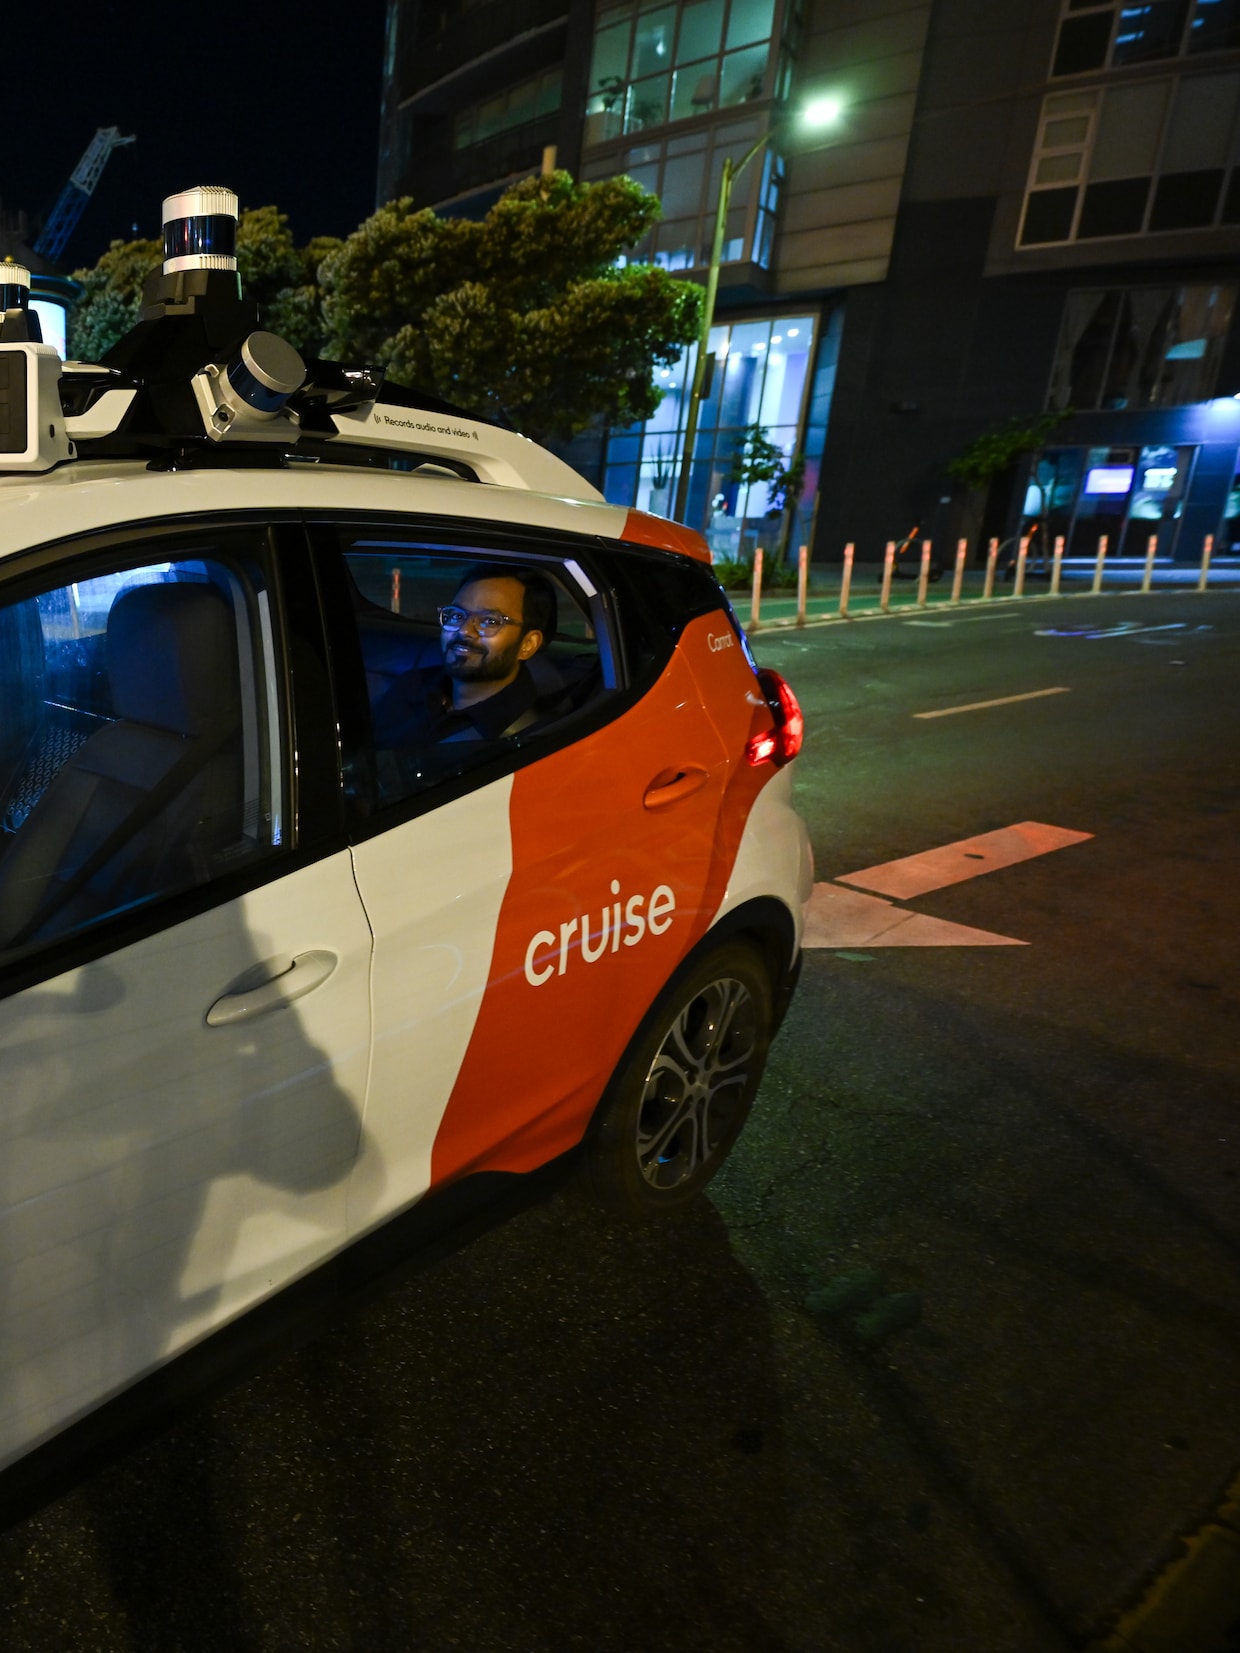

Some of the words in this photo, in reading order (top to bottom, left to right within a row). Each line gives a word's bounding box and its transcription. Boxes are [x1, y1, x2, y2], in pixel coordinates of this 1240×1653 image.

[384, 415, 415, 429] Records
[416, 420, 436, 433] audio
[437, 426, 451, 435] and
[452, 428, 471, 439] video
[524, 879, 676, 987] cruise
